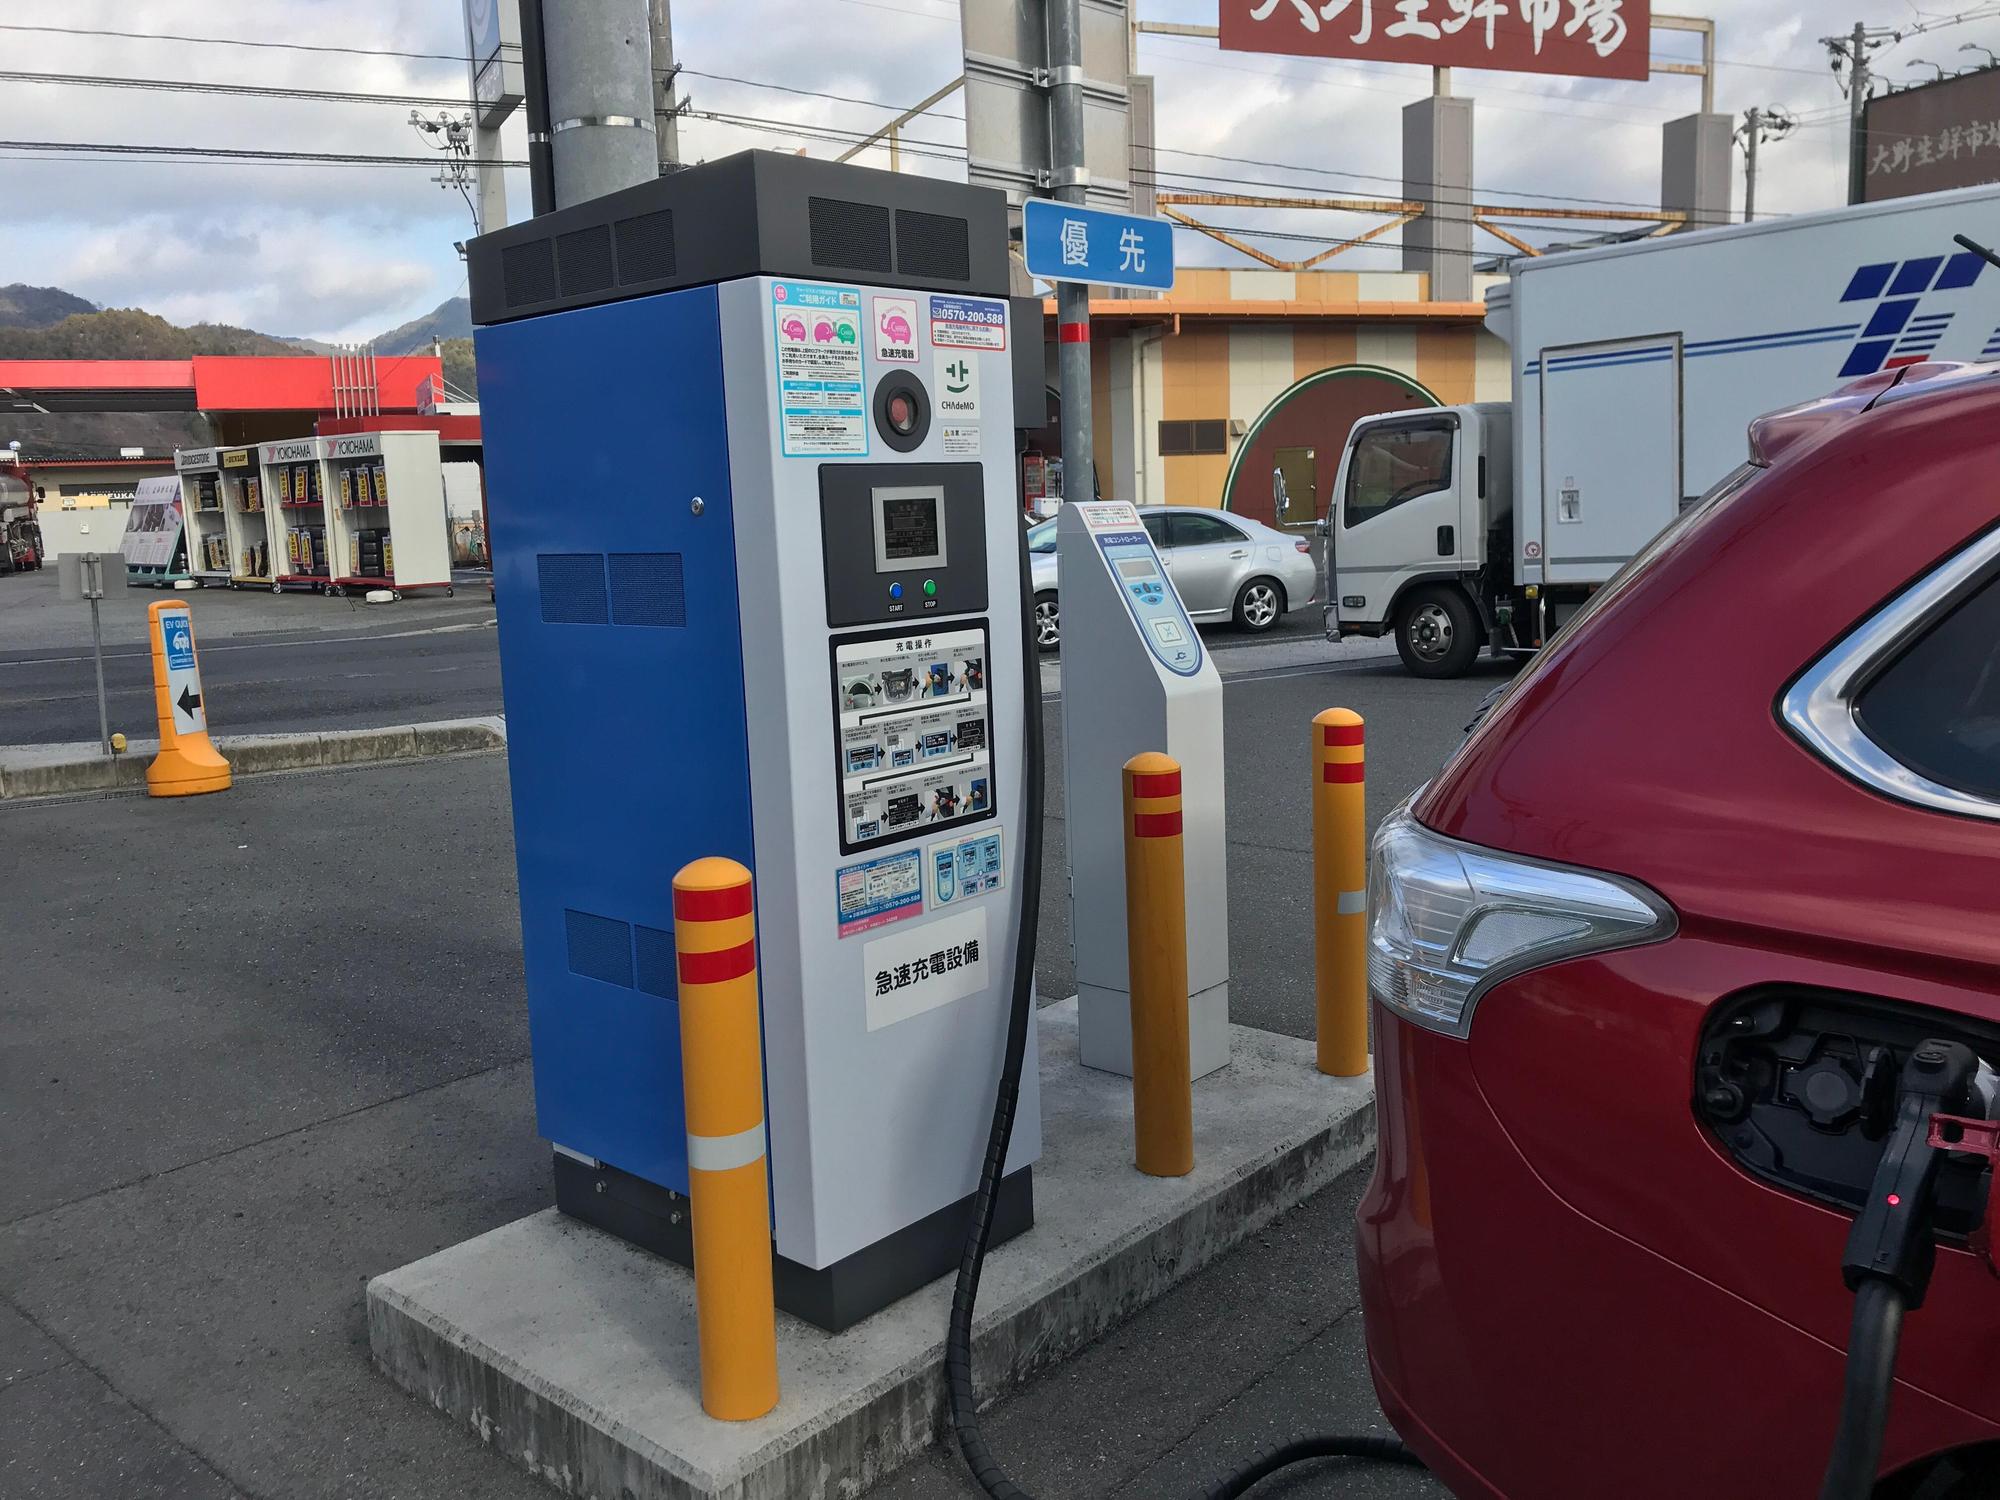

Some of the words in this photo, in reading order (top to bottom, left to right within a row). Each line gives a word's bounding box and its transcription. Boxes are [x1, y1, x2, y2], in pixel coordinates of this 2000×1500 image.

[1060, 218, 1146, 272] 優先
[941, 308, 1003, 324] 0570-200-588
[881, 347, 915, 359] 急速充電器
[941, 401, 975, 410] CHAdeMO
[276, 444, 311, 460] YOKOHAMA
[338, 438, 375, 455] YOKOHAMA
[889, 604, 903, 612] START
[165, 620, 174, 629] EV
[895, 638, 932, 652] 充電操作
[874, 939, 980, 997] 急速充電設備
